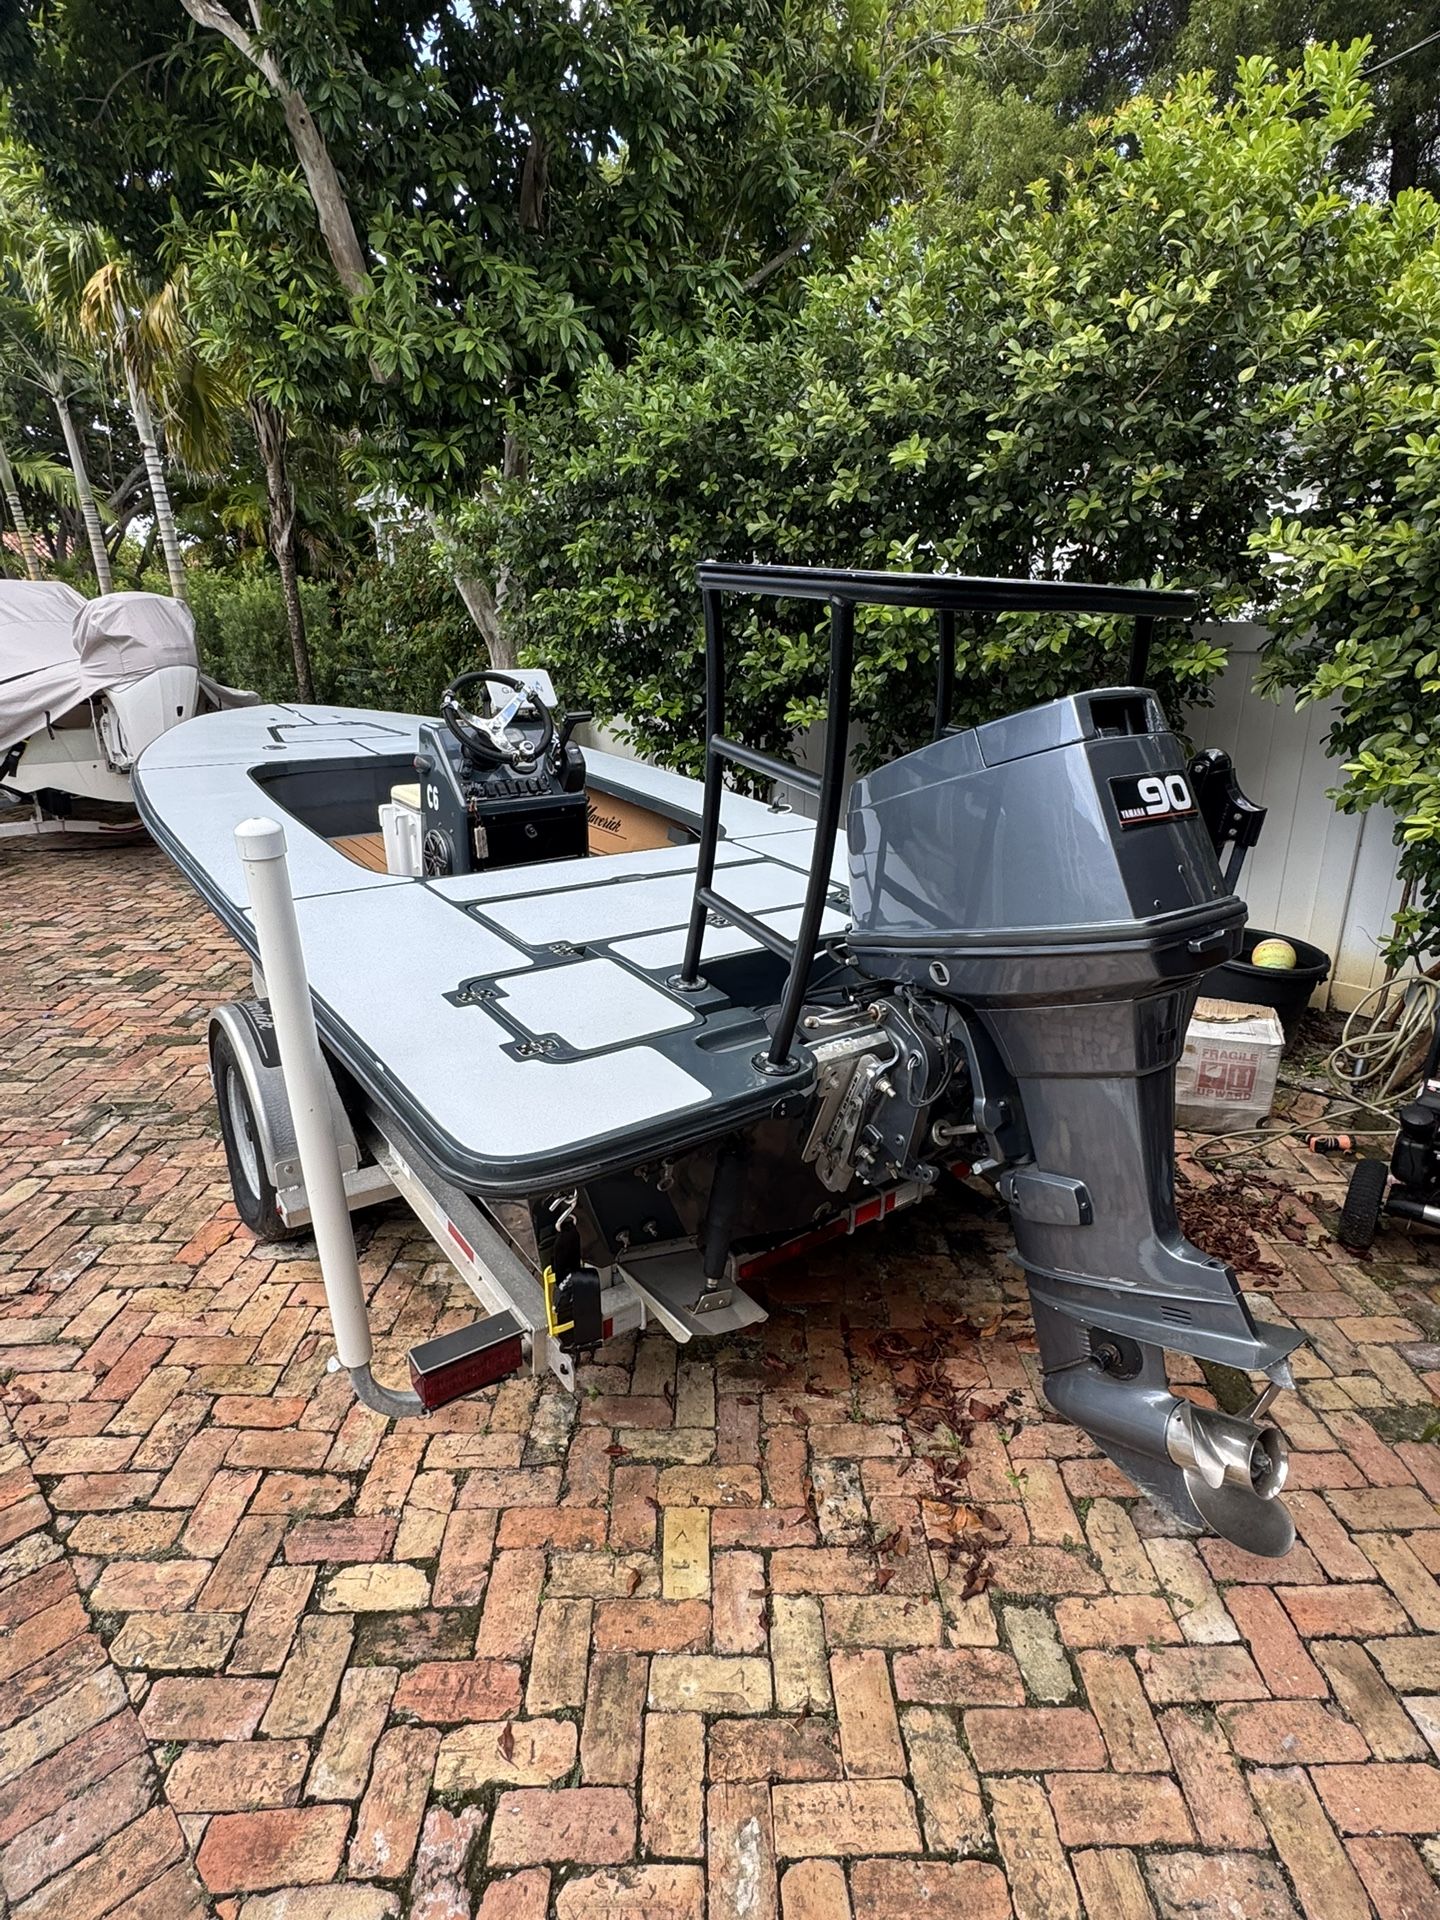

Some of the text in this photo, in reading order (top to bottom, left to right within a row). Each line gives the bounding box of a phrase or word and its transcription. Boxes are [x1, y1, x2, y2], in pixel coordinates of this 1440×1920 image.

[426, 783, 440, 811] C6
[1137, 775, 1192, 815] 90
[1120, 807, 1146, 820] YAMAHA
[1196, 1087, 1252, 1101] UPWARD
